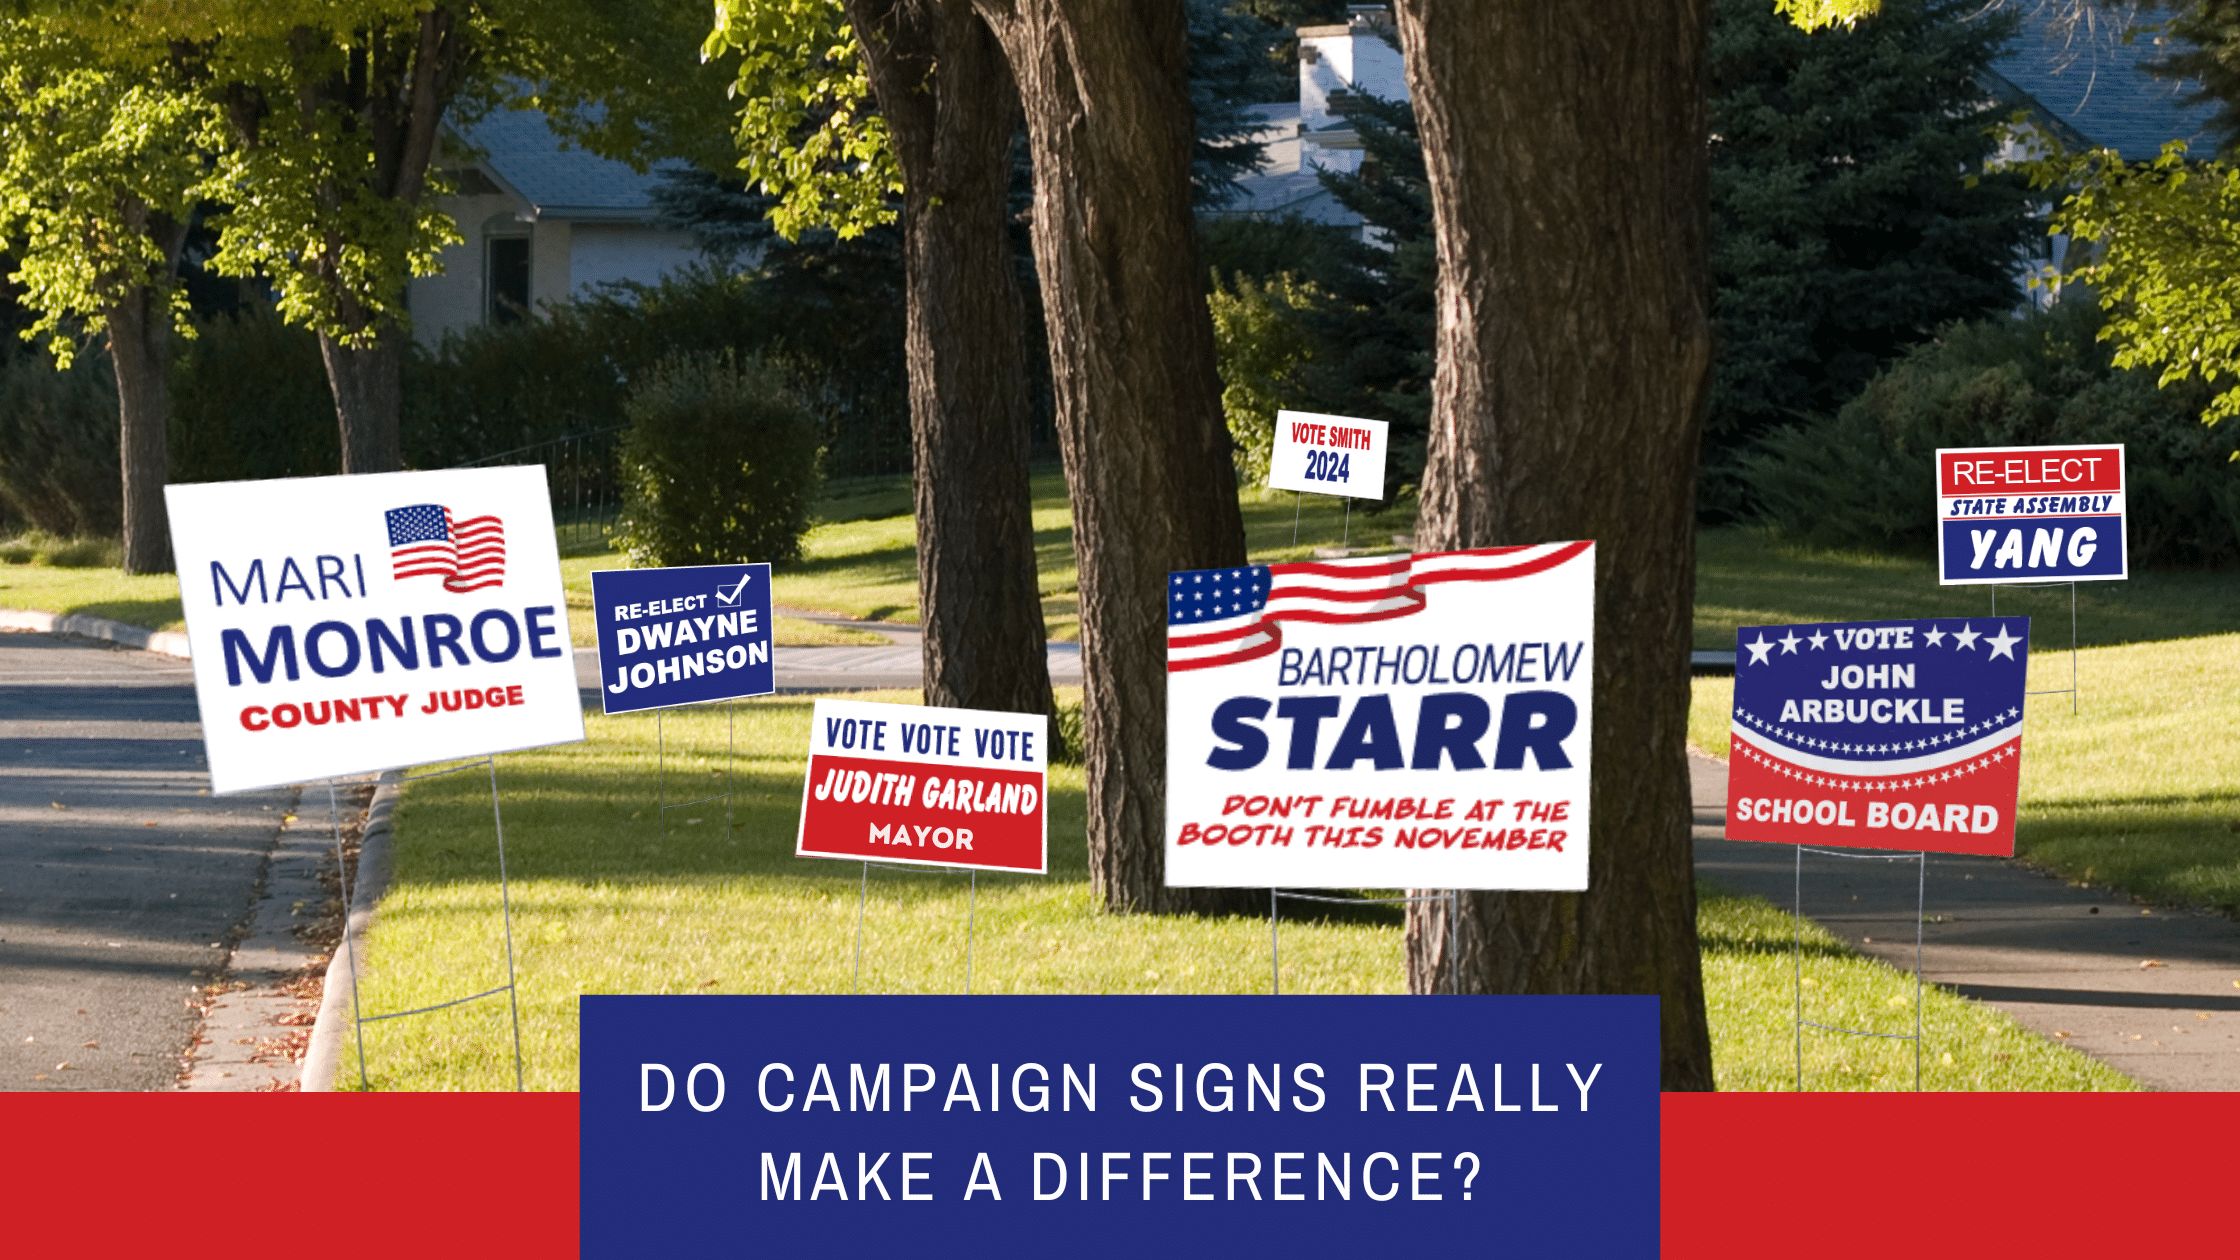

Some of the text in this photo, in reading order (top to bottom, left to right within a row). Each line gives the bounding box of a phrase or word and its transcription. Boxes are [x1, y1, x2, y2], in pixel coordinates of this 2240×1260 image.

[1293, 422, 1370, 450] VOTE SMITH
[1305, 450, 1349, 483] 2024
[1954, 458, 2101, 485] RE-ELECT
[1951, 496, 2112, 516] STATE ASSEMBLY
[1971, 527, 2097, 569] YANG
[211, 554, 366, 606] MARI
[615, 594, 707, 621] RE-ELECT
[221, 606, 562, 686] MONROE
[617, 610, 759, 656] DWAYNE
[1834, 627, 1913, 650] VOTE
[607, 639, 769, 694] JOHNSON
[1278, 642, 1583, 686] BARTHOLOMEW
[1822, 664, 1914, 689] JOHN
[240, 685, 524, 731] COUNTY JUDGE
[1780, 699, 1964, 723] ARBUCKLE
[827, 718, 1033, 761] VOTE VOTE VOTE
[1206, 690, 1577, 771] STARR
[815, 769, 1037, 815] JUDITH GARLAND
[1222, 795, 1569, 822] DON'T FUMBLE AT THE
[1737, 798, 1998, 833] SCHOOL BOARD
[869, 823, 973, 850] MAYOR
[1177, 823, 1567, 852] BOOTH THIS NOVEMBER
